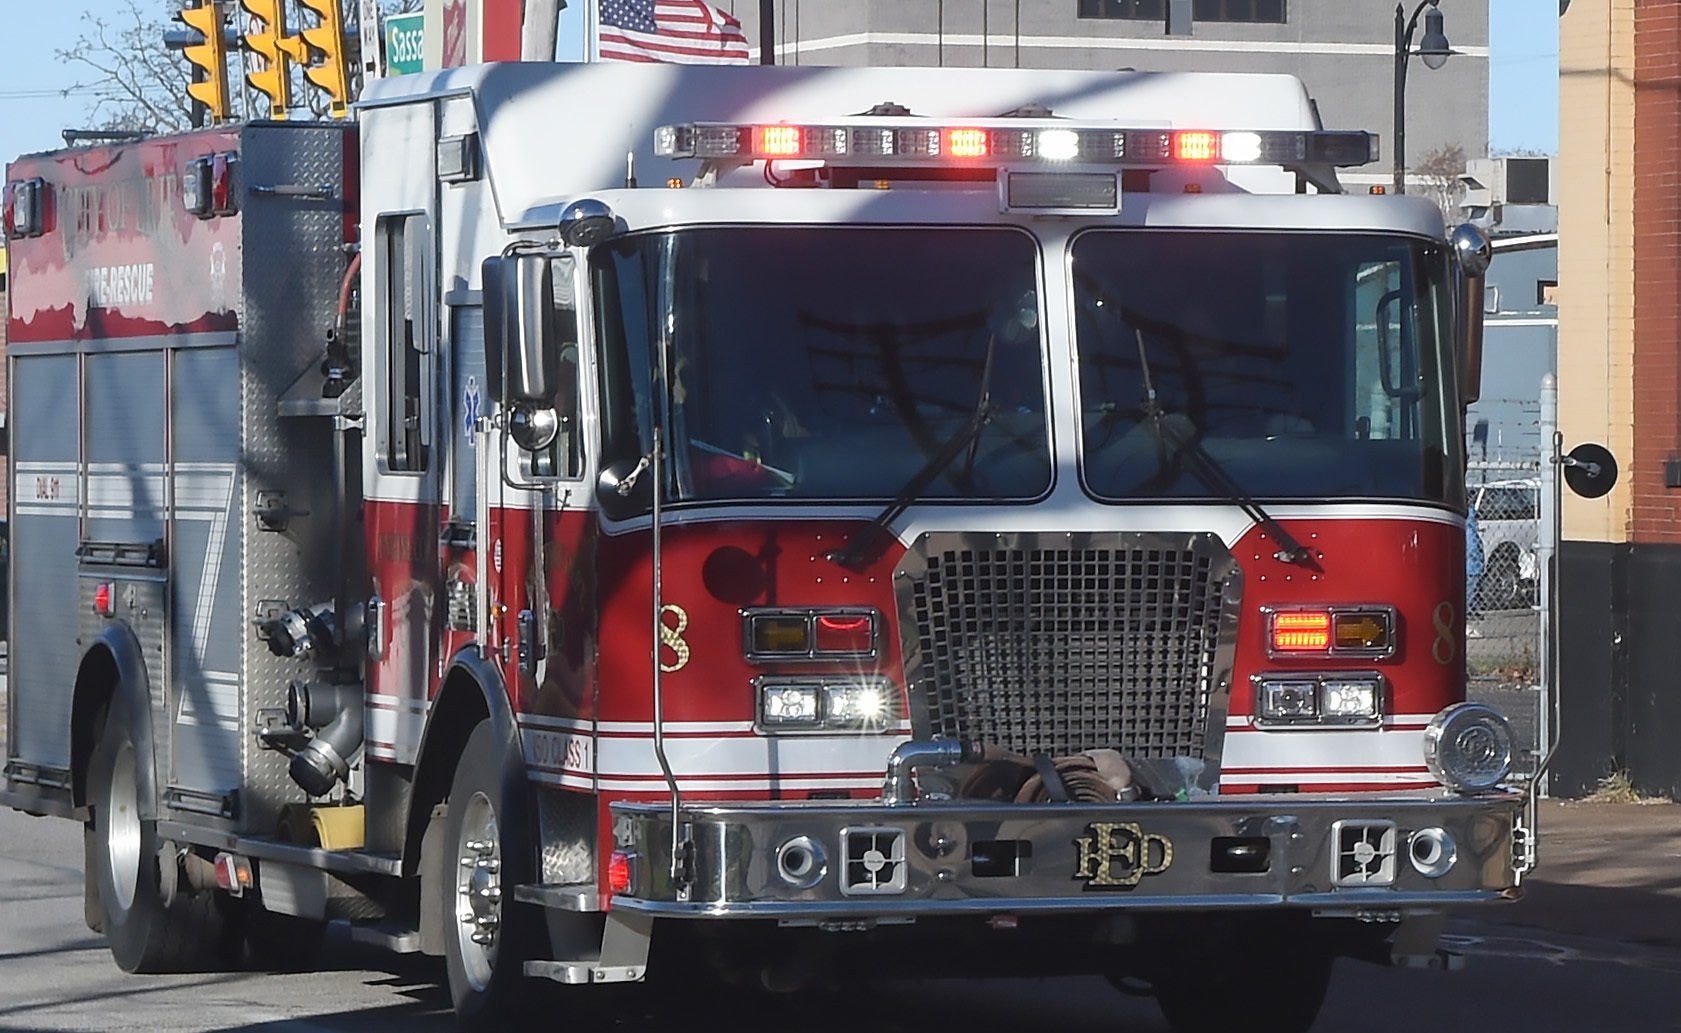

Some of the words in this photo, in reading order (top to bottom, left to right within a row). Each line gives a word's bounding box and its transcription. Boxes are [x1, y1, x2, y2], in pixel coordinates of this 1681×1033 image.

[651, 604, 690, 673] 8
[1432, 601, 1455, 665] 8
[583, 742, 590, 769] 1
